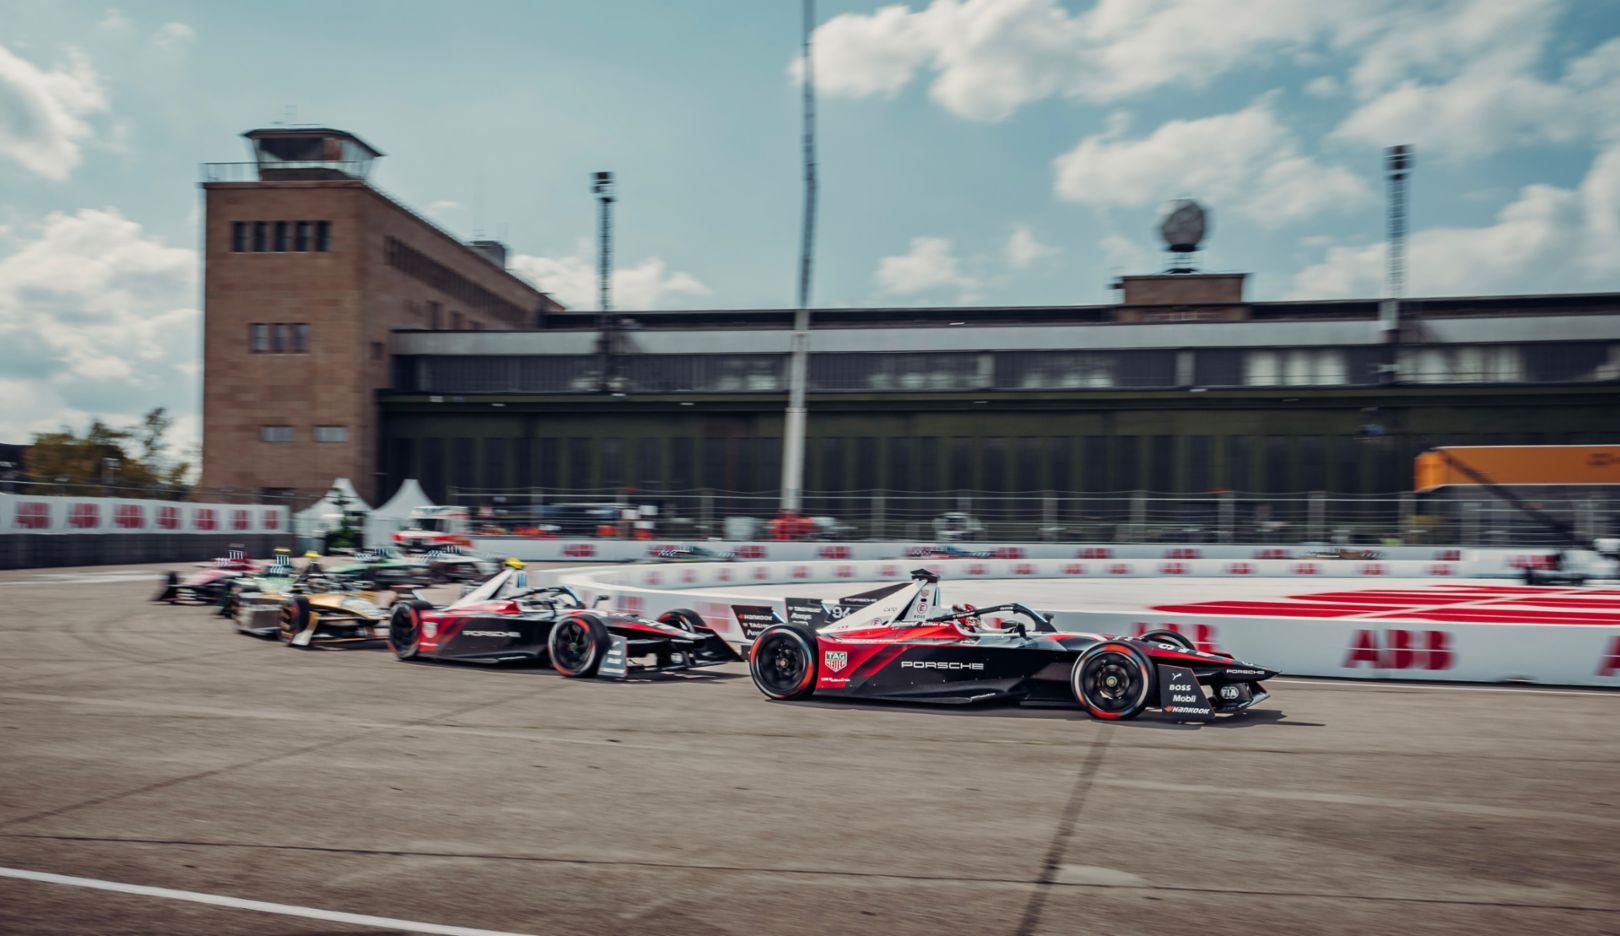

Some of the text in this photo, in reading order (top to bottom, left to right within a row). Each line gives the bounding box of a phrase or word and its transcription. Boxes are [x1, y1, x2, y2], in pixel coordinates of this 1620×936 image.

[1341, 629, 1459, 670] ABB
[827, 652, 845, 660] TAG
[901, 661, 984, 670] PORSCHE
[1221, 686, 1237, 699] FIA
[1172, 694, 1197, 703] Mobil
